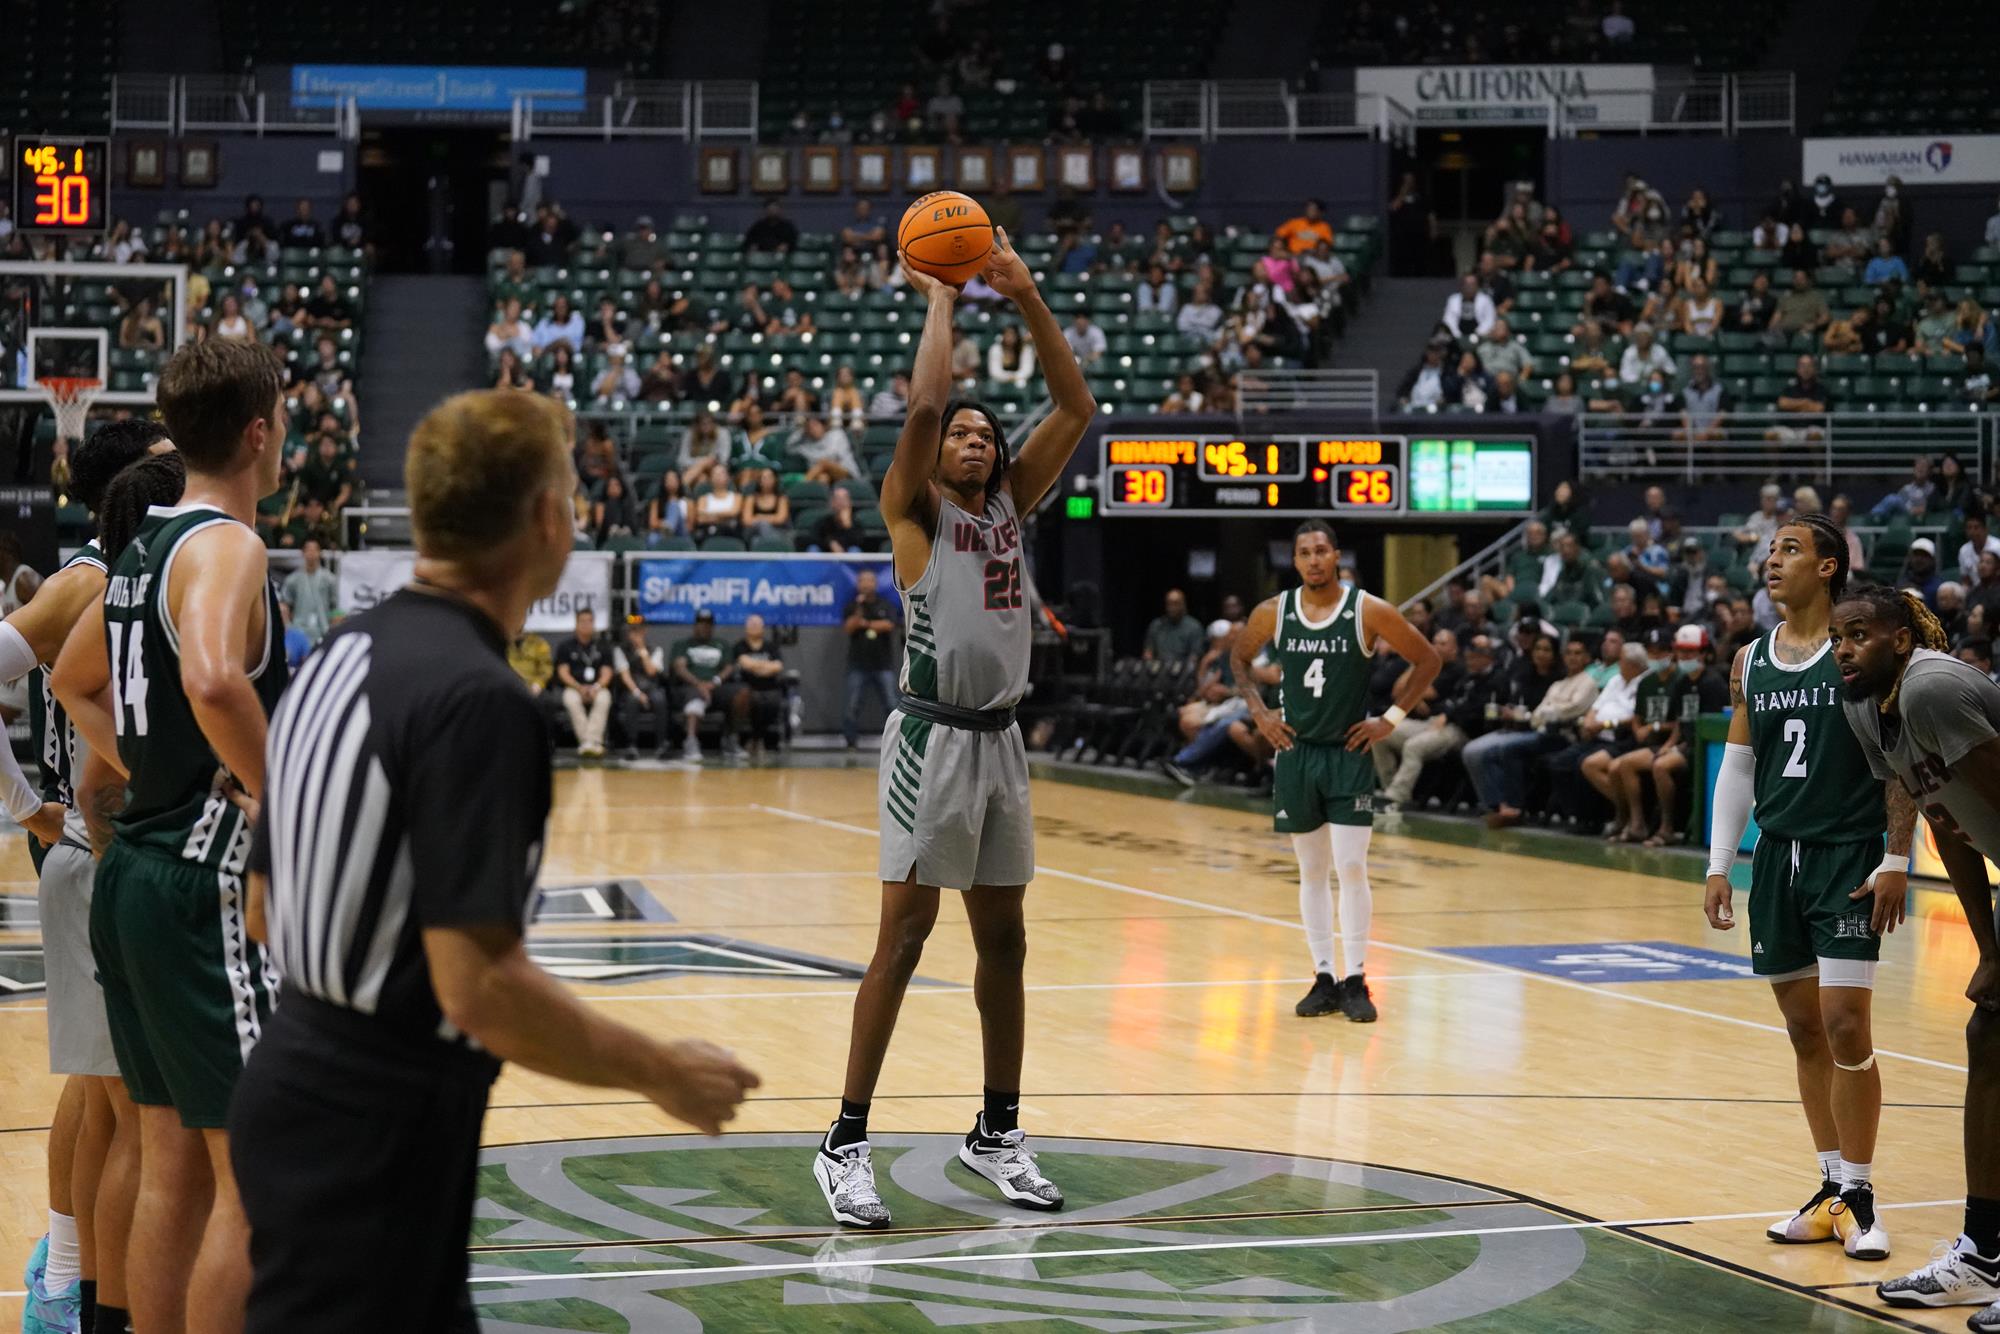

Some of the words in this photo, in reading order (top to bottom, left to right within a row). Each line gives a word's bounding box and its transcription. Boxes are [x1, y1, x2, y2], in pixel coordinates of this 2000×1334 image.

[1416, 69, 1588, 101] CALIFORNIA
[25, 146, 83, 175] 45.1
[1839, 151, 1921, 166] HAWAIIAN
[35, 175, 89, 224] 30
[1205, 442, 1279, 477] 45.1
[1125, 470, 1165, 503] 30
[1216, 488, 1261, 504] PERIOD
[1267, 483, 1279, 507] 1
[1348, 470, 1391, 504] 26
[643, 576, 750, 609] SimpliFi
[752, 577, 834, 606] Arena
[1286, 636, 1349, 653] HAWAI'I
[108, 620, 150, 736] 14
[1303, 658, 1327, 698] 4
[1754, 682, 1836, 712] HAWAI'I
[1782, 719, 1807, 777] 2
